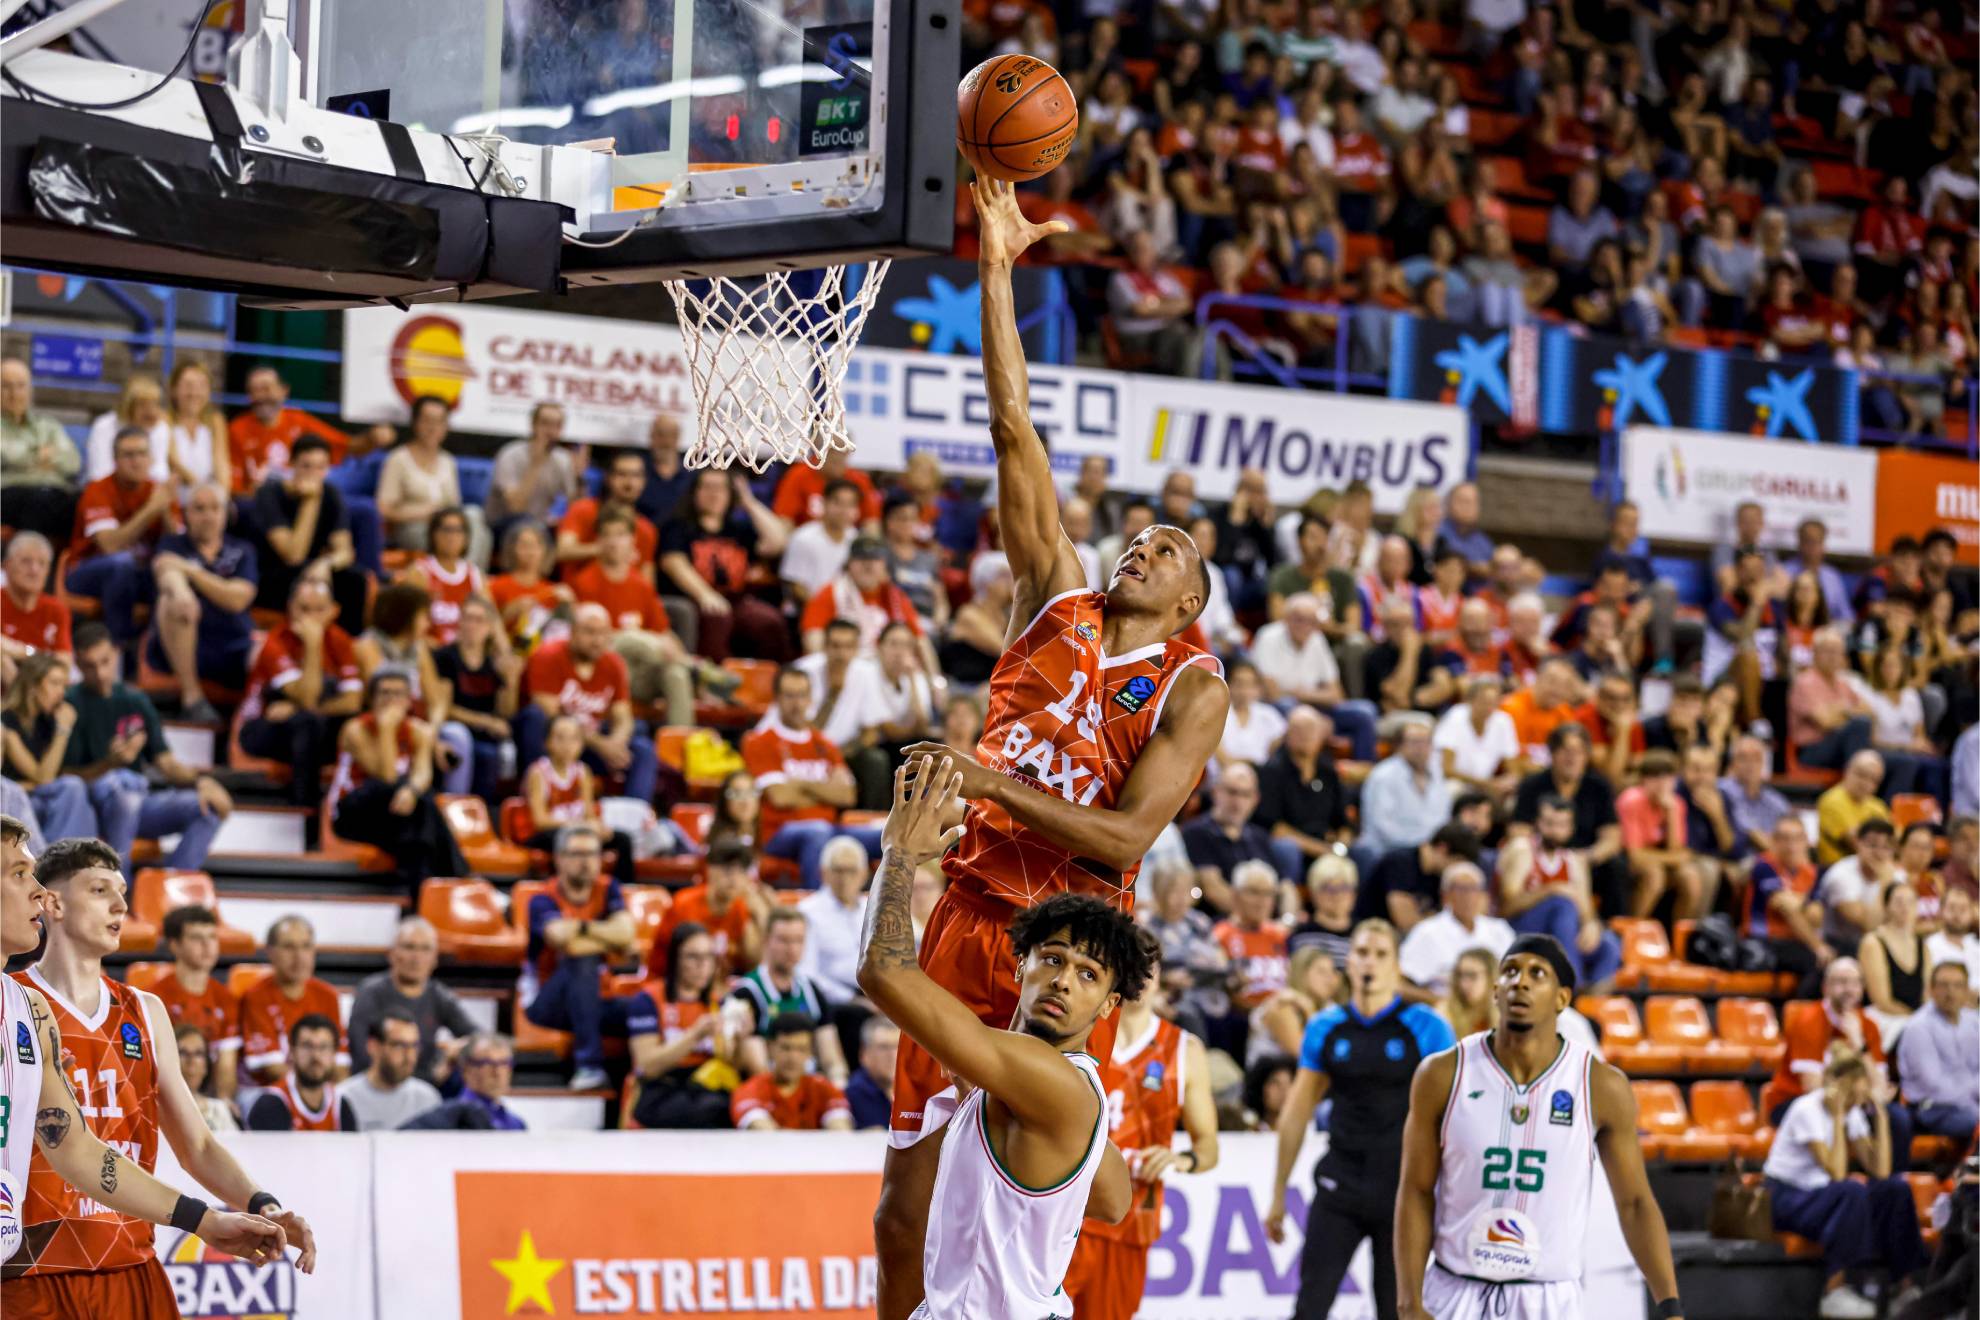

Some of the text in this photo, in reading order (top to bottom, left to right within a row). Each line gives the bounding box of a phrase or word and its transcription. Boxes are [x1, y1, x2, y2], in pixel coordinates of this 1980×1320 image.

[817, 101, 860, 121] BKT
[812, 128, 864, 147] EuroCup
[488, 335, 686, 377] CATALANA
[489, 369, 689, 412] DE TREBALL
[1115, 694, 1137, 712] EuroCup
[1122, 692, 1140, 704] BKT
[1000, 721, 1105, 806] BAXI
[73, 1068, 124, 1118] 11
[1482, 1147, 1547, 1193] 25
[1473, 1248, 1531, 1265] aquapark
[165, 1263, 290, 1316] BAXI
[573, 1256, 877, 1314] ESTRELLA DA
